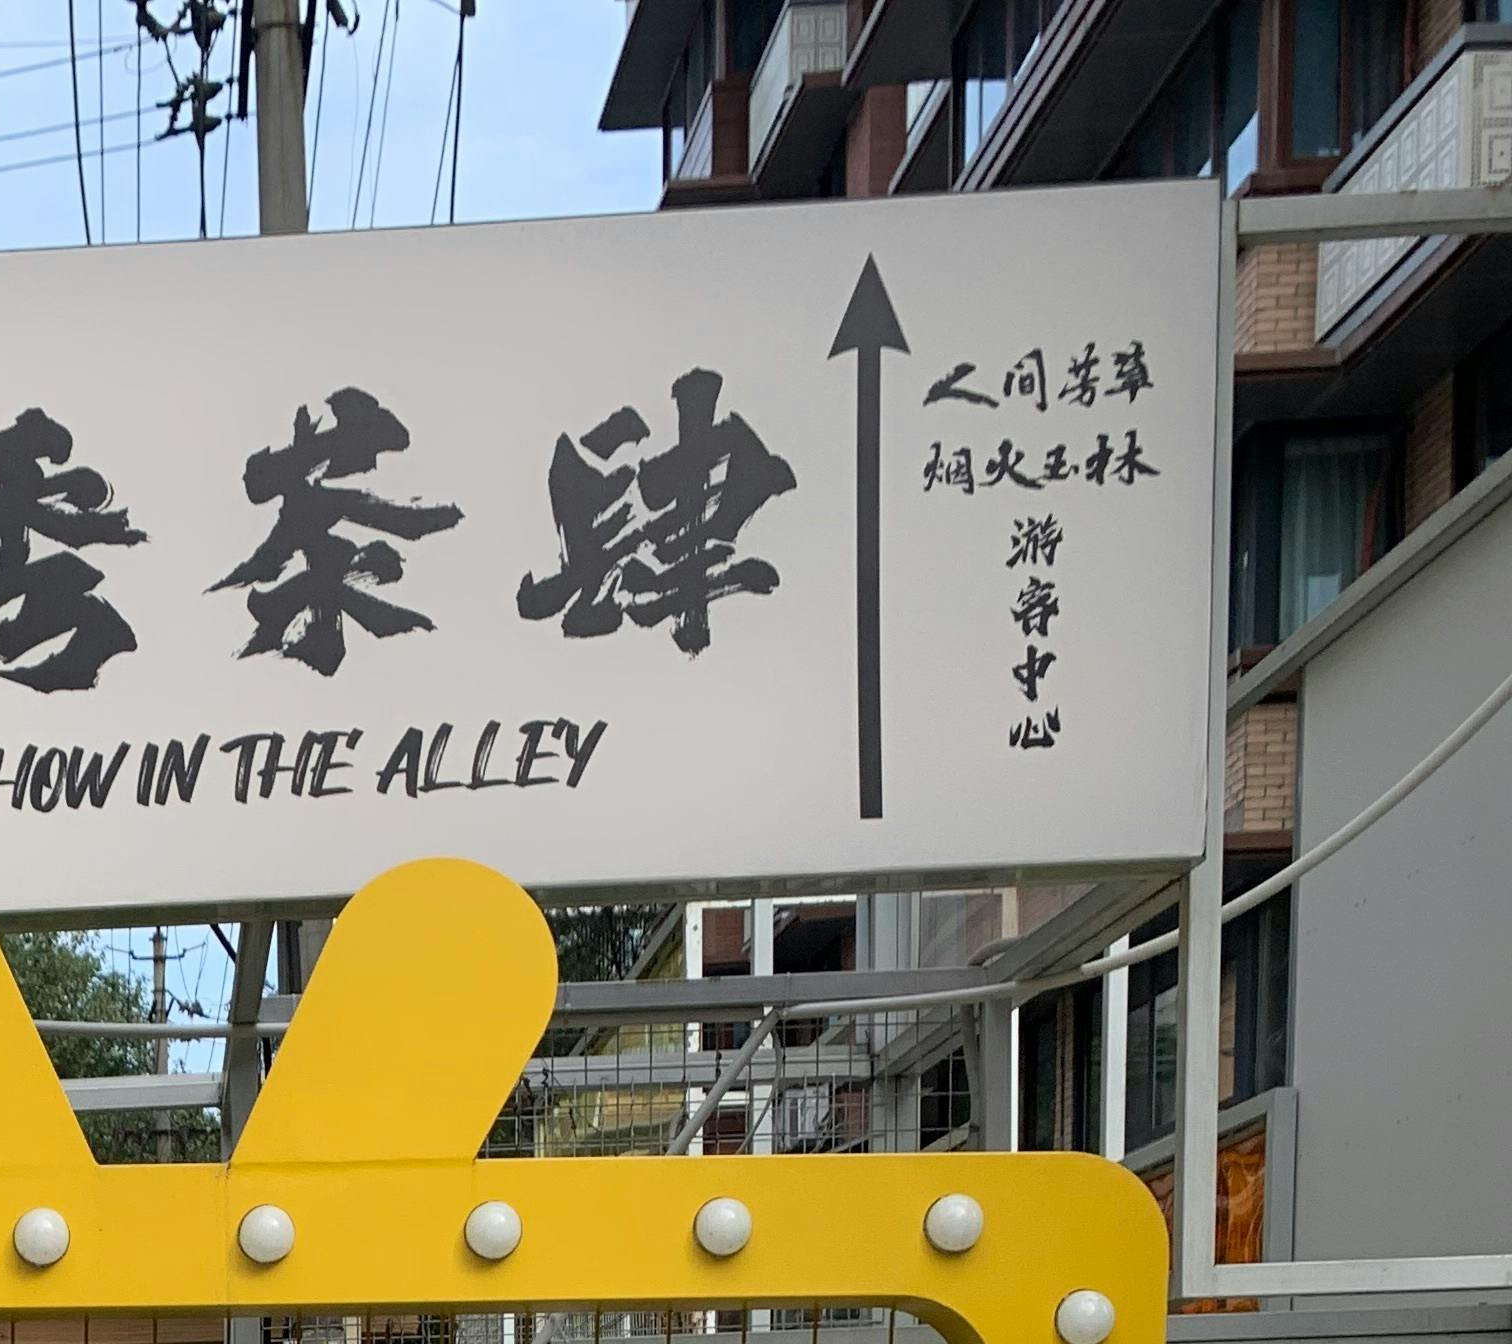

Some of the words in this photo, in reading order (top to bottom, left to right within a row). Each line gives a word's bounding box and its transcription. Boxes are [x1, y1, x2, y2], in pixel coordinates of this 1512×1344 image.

[922, 428, 1161, 496] 烟火玉林
[1005, 512, 1064, 751] 游客中心
[136, 732, 211, 807] IN
[219, 728, 364, 804] THE
[376, 716, 609, 798] ALLEY
